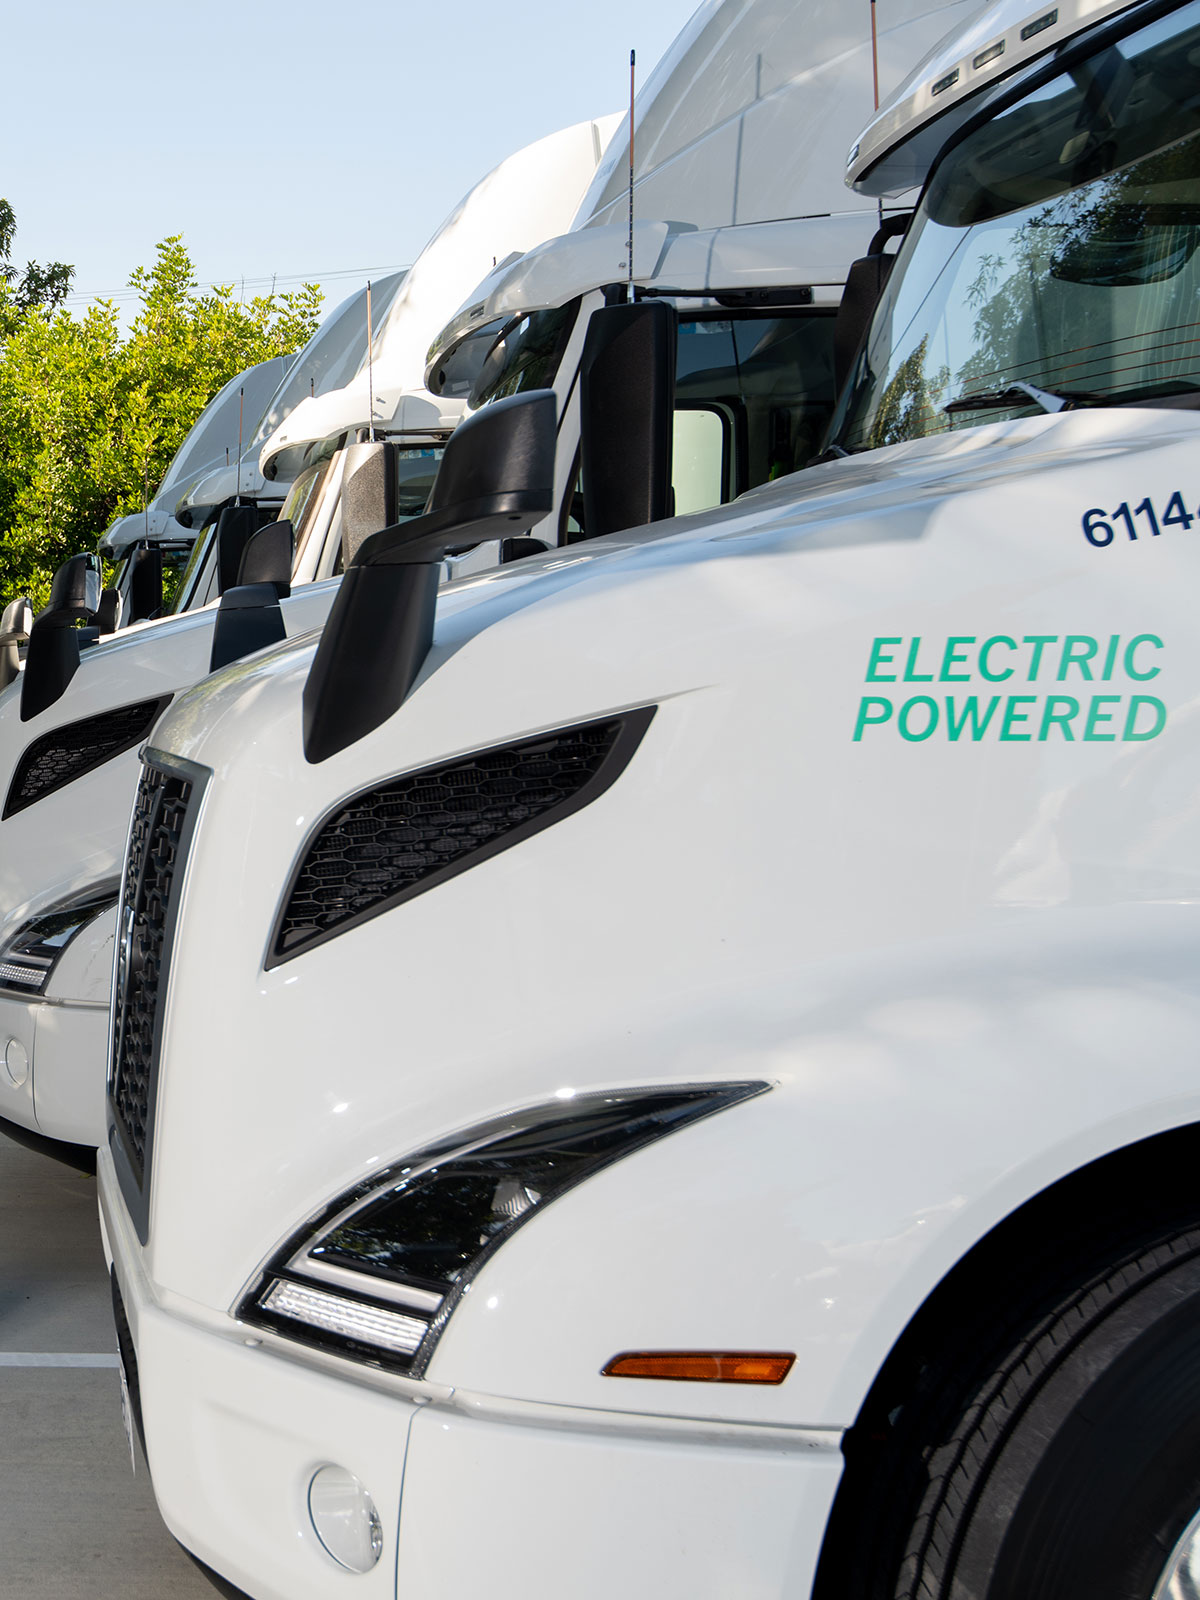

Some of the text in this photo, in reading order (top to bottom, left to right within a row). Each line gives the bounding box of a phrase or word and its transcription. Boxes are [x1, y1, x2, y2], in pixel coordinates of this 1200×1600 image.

[1082, 490, 1200, 548] 6114
[864, 633, 1165, 683] ELECTRIC
[852, 694, 1168, 742] POWERED
